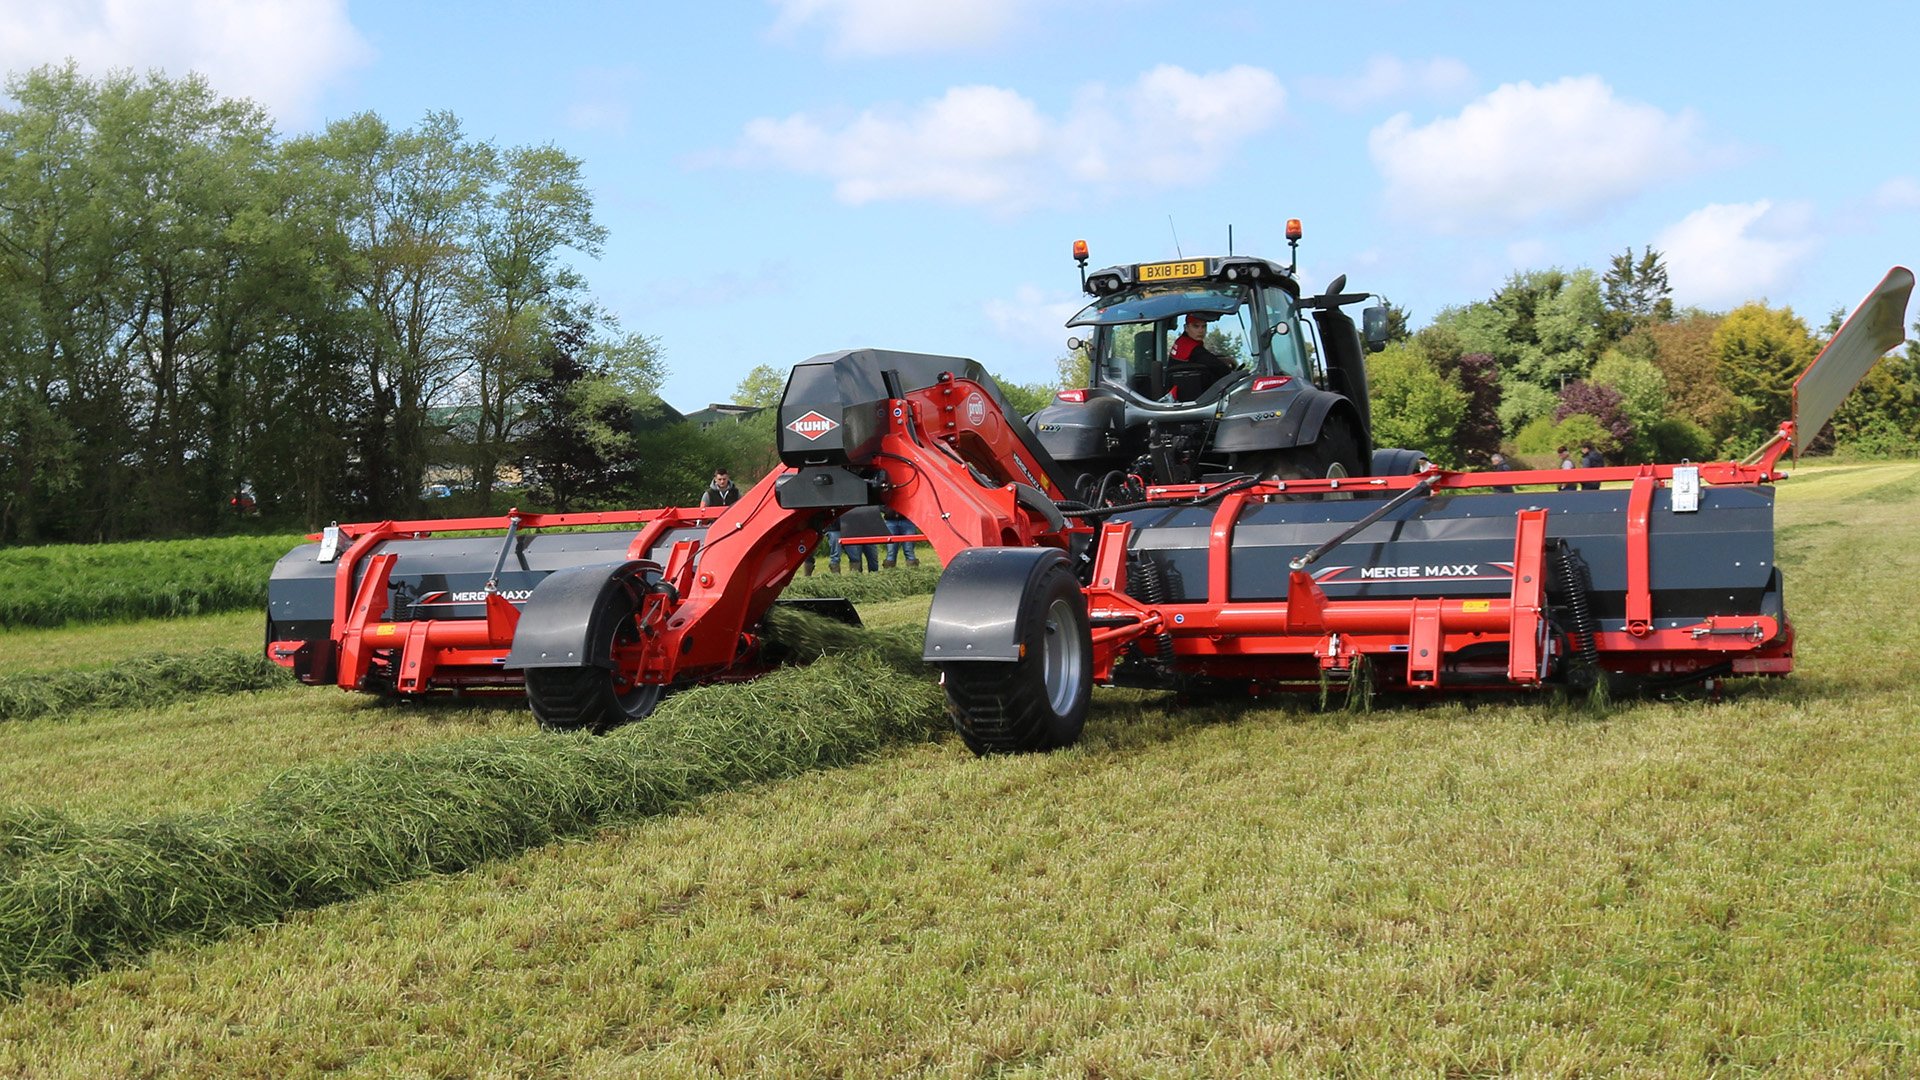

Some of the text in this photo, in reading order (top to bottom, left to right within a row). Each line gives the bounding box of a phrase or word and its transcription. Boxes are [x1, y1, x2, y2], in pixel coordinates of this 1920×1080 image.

[1147, 266, 1171, 278] BX18
[795, 420, 830, 431] KUHN
[1361, 564, 1478, 578] MERGE MAXX
[452, 591, 489, 601] MERG
